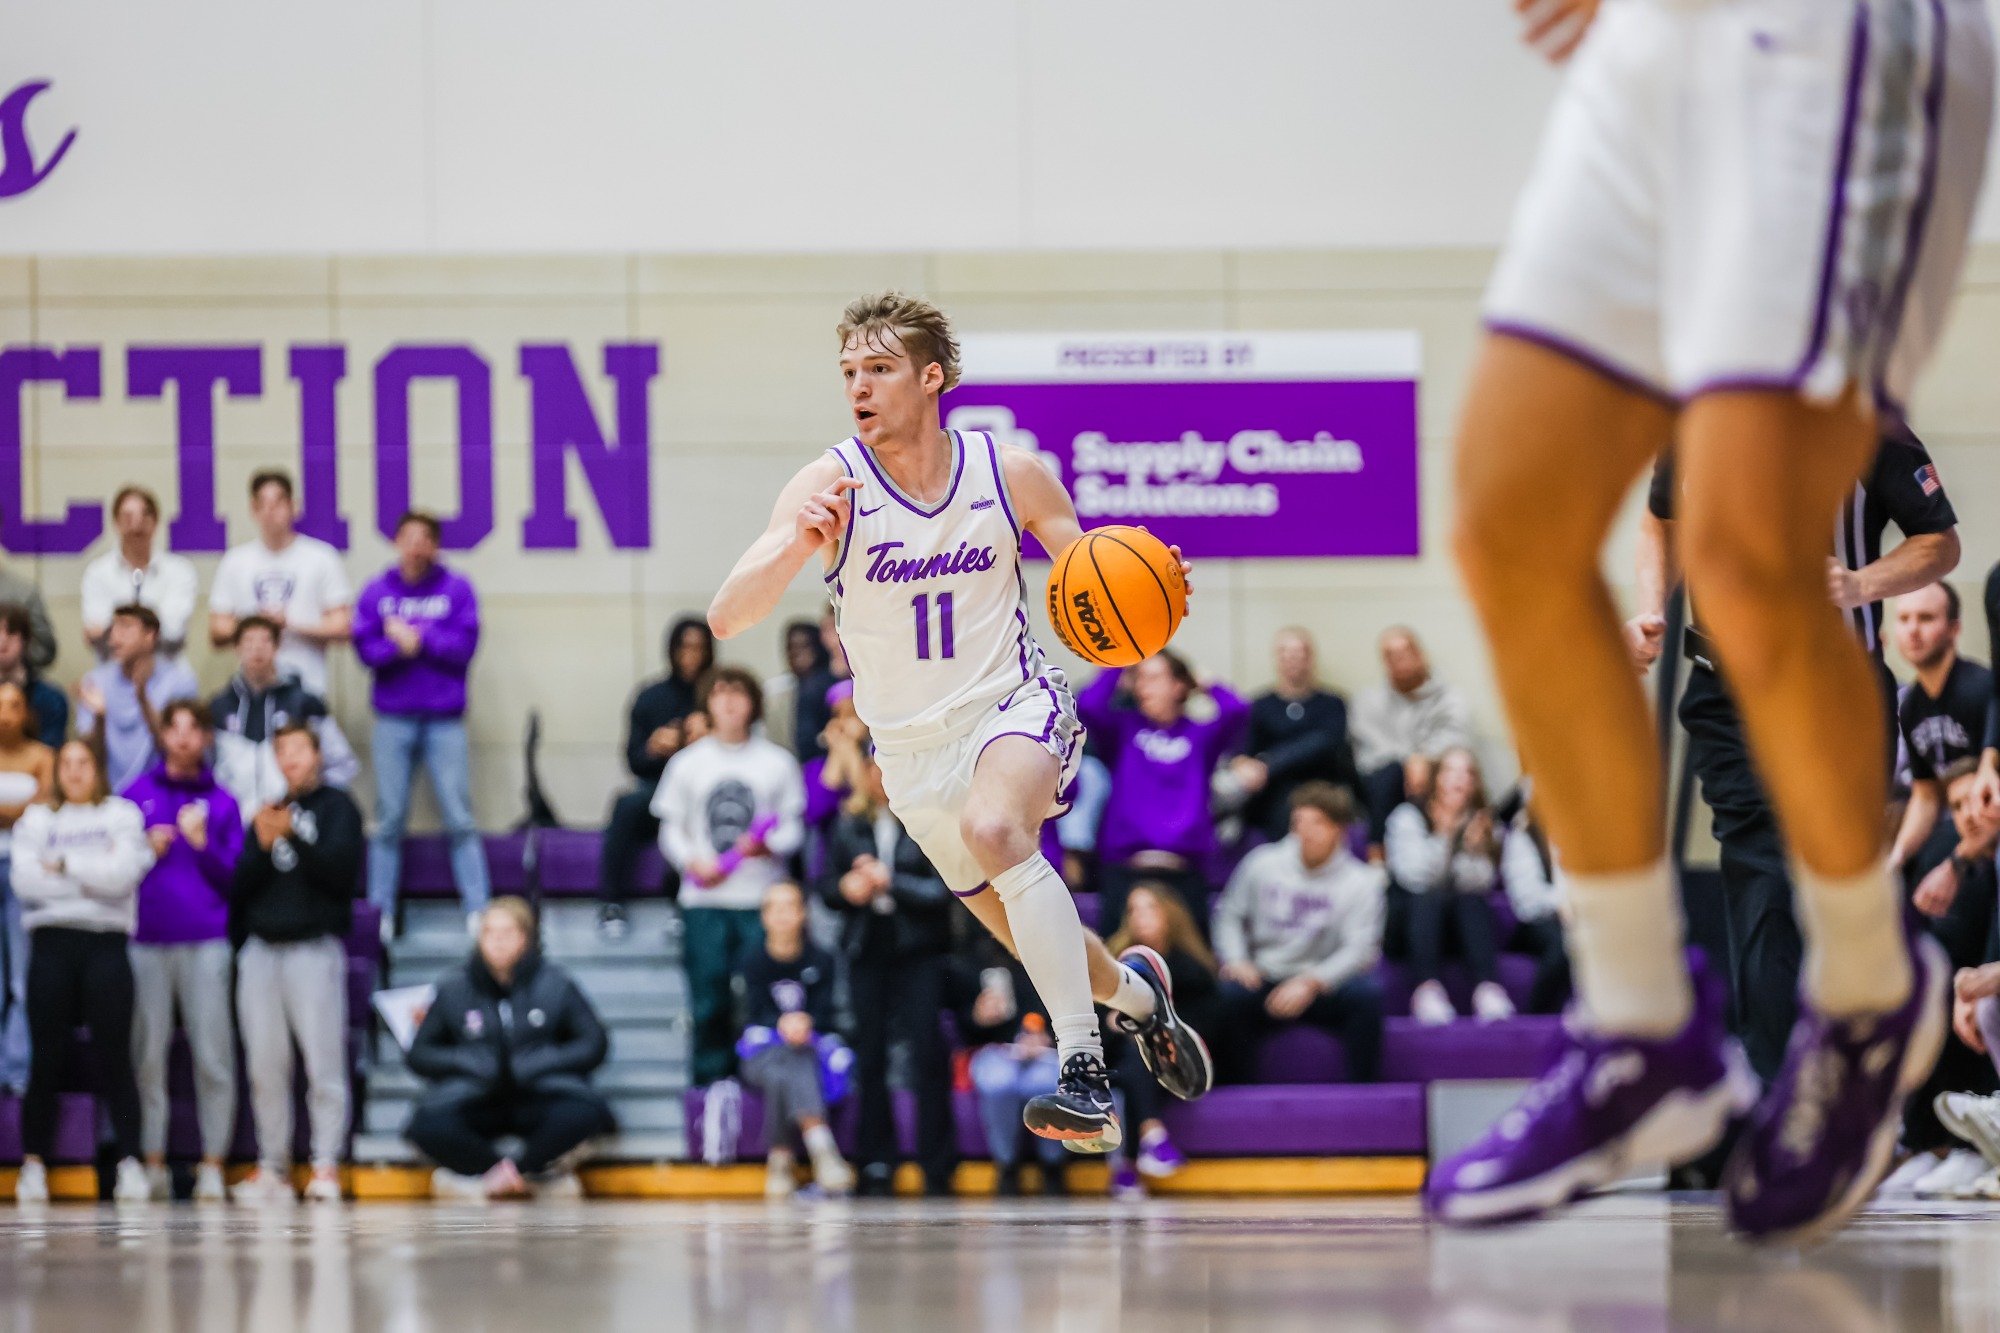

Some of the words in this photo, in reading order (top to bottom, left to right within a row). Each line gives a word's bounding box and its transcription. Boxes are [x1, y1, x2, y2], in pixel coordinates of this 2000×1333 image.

[0, 343, 661, 553] CTION
[1072, 430, 1226, 481] Supply
[1227, 429, 1364, 474] Chain
[1074, 474, 1279, 517] Solutions
[866, 541, 997, 583] Tommies
[910, 590, 956, 661] 11
[1073, 590, 1118, 652] NCAA
